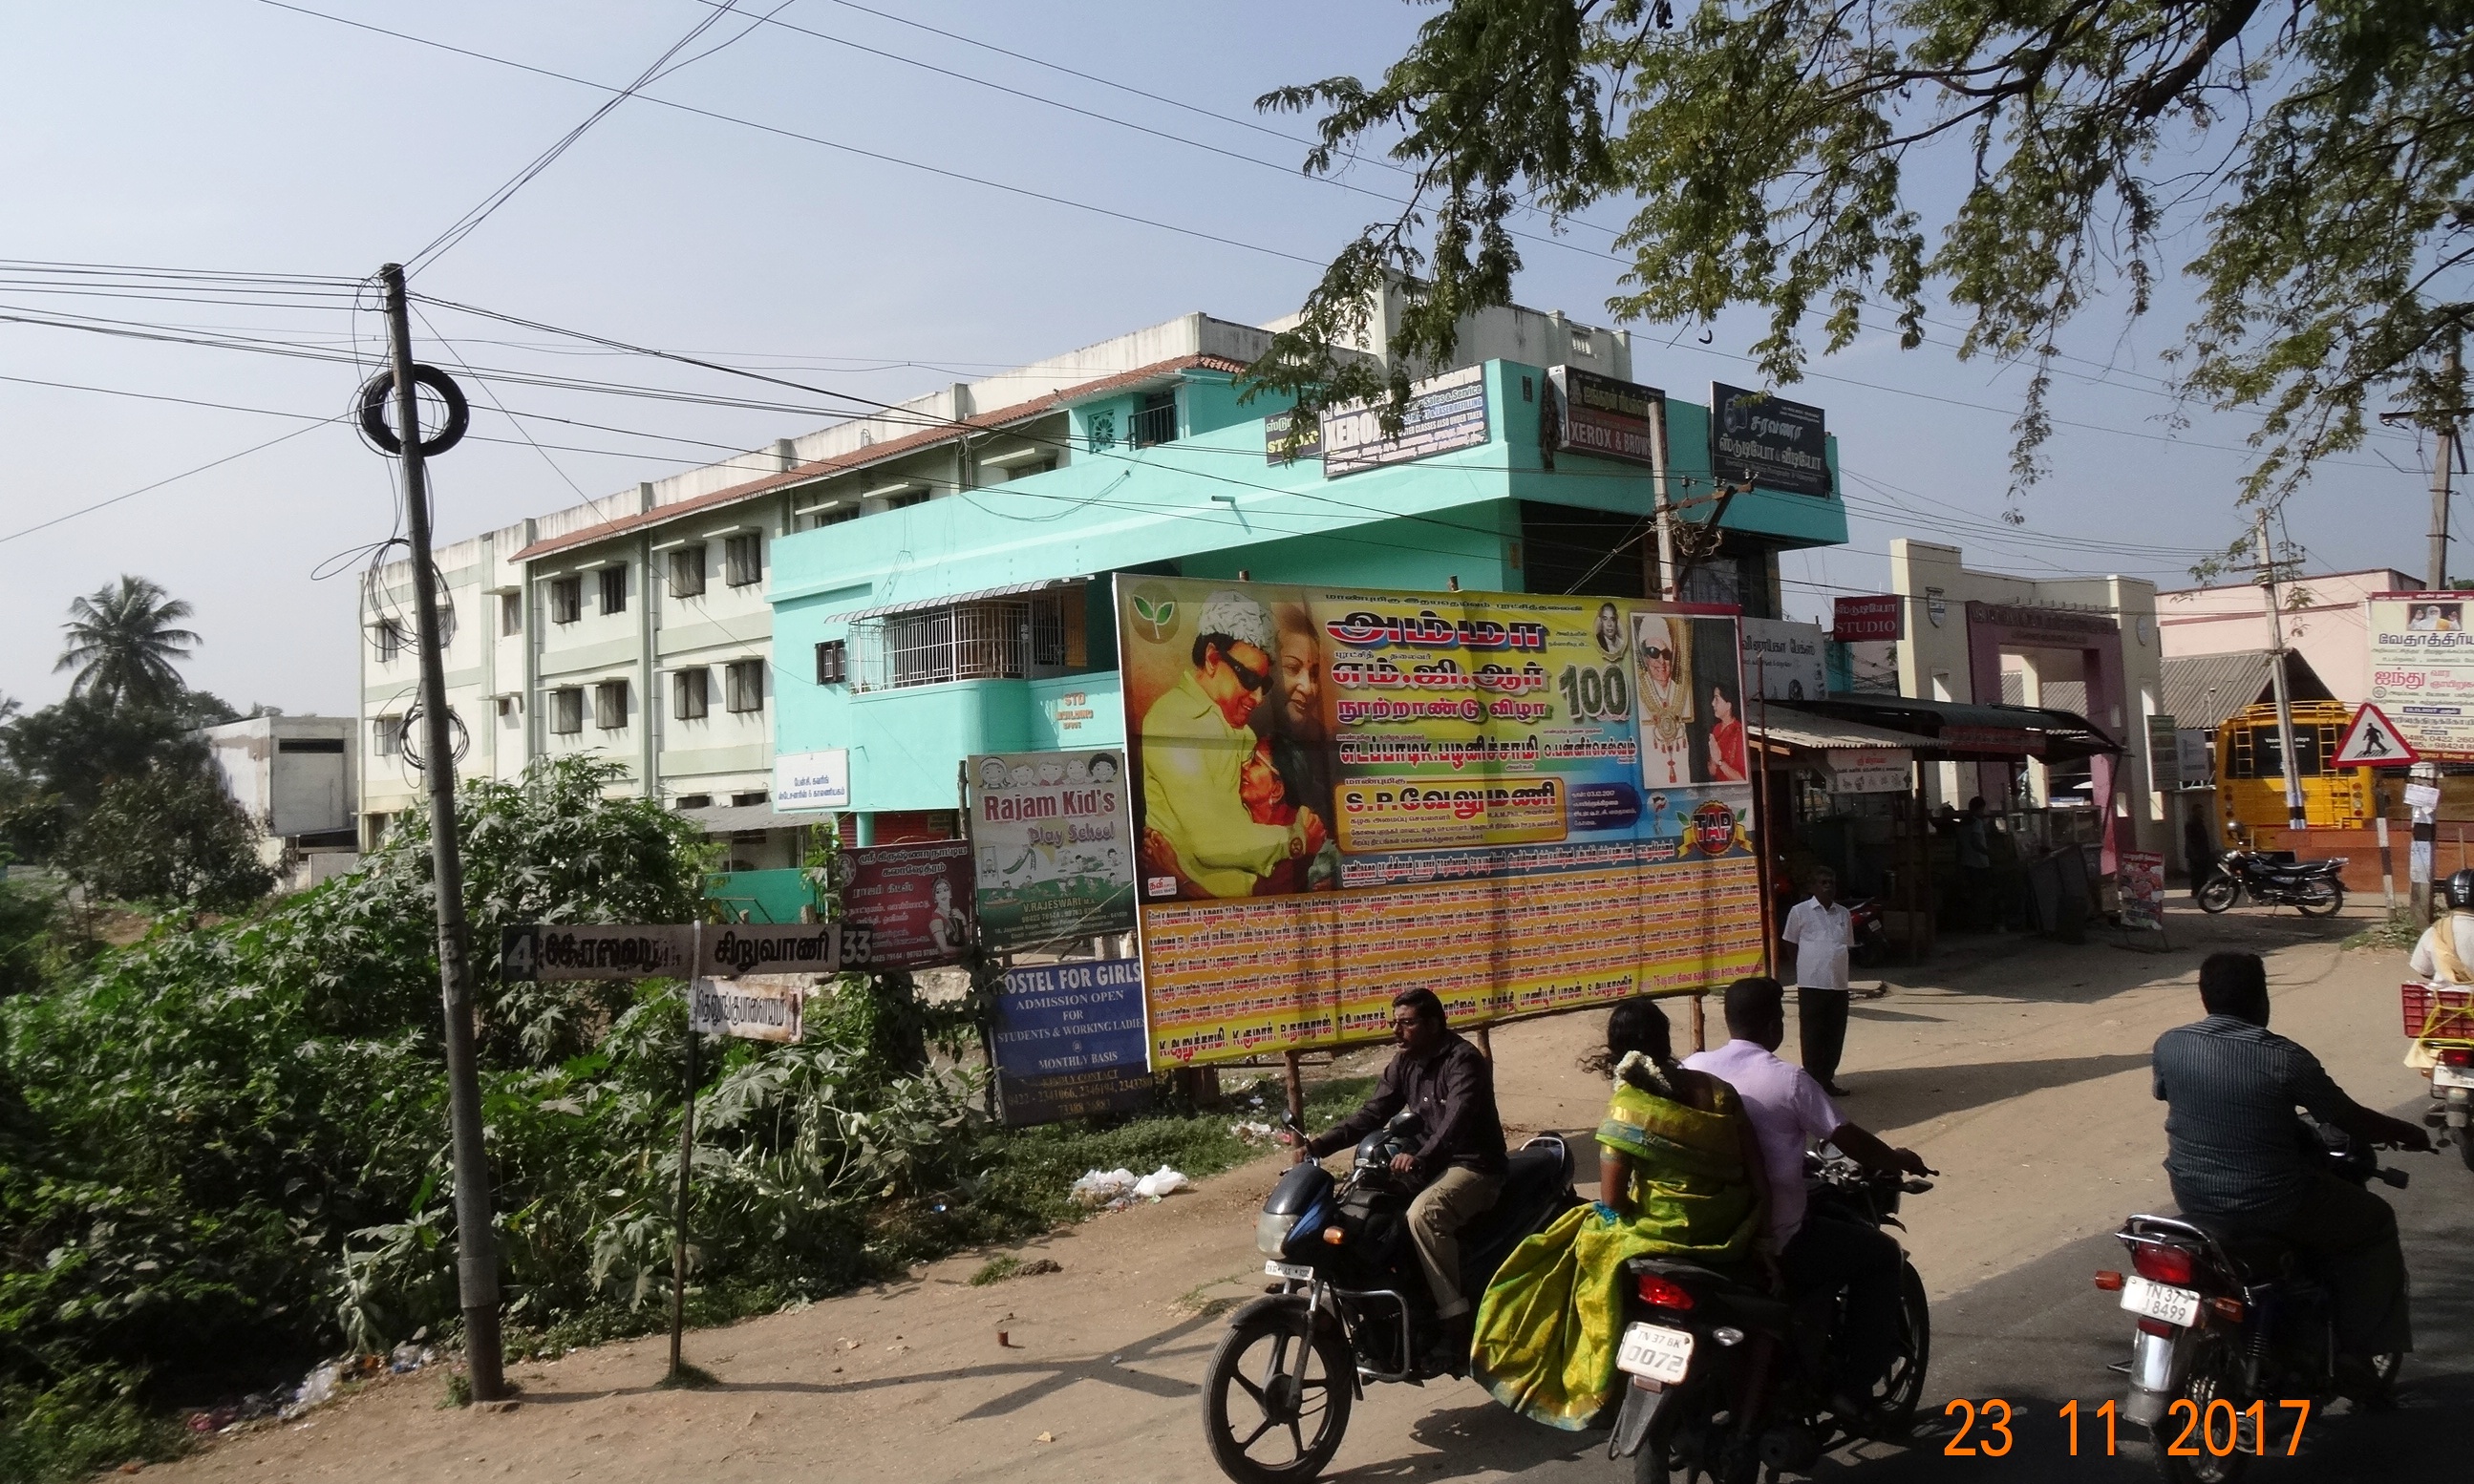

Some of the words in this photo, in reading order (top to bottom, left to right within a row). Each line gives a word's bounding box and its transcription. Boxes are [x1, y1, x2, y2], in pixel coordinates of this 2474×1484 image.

[1452, 385, 1482, 400] Service
[1569, 420, 1611, 449] XEROX
[1615, 431, 1622, 451] &
[1751, 415, 1802, 441] சரவணா
[1719, 433, 1775, 461] ஸ்டுடியோ
[1326, 592, 1401, 604] மாண்புமிகு
[1835, 601, 1896, 617] ஸ்டுடியோ
[1326, 610, 1545, 647] அம்மா
[1835, 620, 1896, 633] STUDIO
[1335, 650, 1375, 660] புரட்சித்
[1389, 651, 1432, 660] தலைவர்
[1332, 657, 1546, 691] எம்.ஜி.ஆர்
[2375, 670, 2426, 690] ஐந்து
[1559, 665, 1630, 718] 100
[1337, 698, 1479, 723] நூற்றாண்டு
[1489, 698, 1546, 719] விழா
[984, 794, 1056, 822] Rajam
[1062, 789, 1116, 817] Kid's
[1345, 779, 1556, 819] S.P.வேலுமணி
[1350, 817, 1371, 826] கழக
[1693, 812, 1732, 842] TAP
[1028, 826, 1063, 847] Play
[1068, 822, 1115, 842] School
[1023, 897, 1081, 913] V.RAJESWARI
[507, 934, 534, 973] 4
[842, 930, 871, 964] 33
[1005, 970, 1054, 994] OSTEL
[1059, 967, 1093, 989] FOR
[1097, 962, 1141, 986] GIRLS
[1016, 994, 1088, 1010] ADMISSION
[1091, 990, 1124, 1003] OPEN
[1063, 1010, 1084, 1021] FOR
[998, 1029, 1050, 1042] STUDENTS
[1053, 1028, 1060, 1037] &
[1062, 1021, 1111, 1035] WORKING
[1073, 1040, 1081, 1052] @
[1038, 1054, 1089, 1069] MONTHLY
[1092, 1051, 1118, 1064] BASIS
[1077, 1070, 1119, 1083] CONTACT
[2146, 1283, 2163, 1300] TN
[2152, 1301, 2186, 1321] 8499
[1640, 1330, 1651, 1341] TN
[1652, 1334, 1665, 1345] 37
[1667, 1337, 1681, 1348] BK
[1626, 1345, 1684, 1373] 0072
